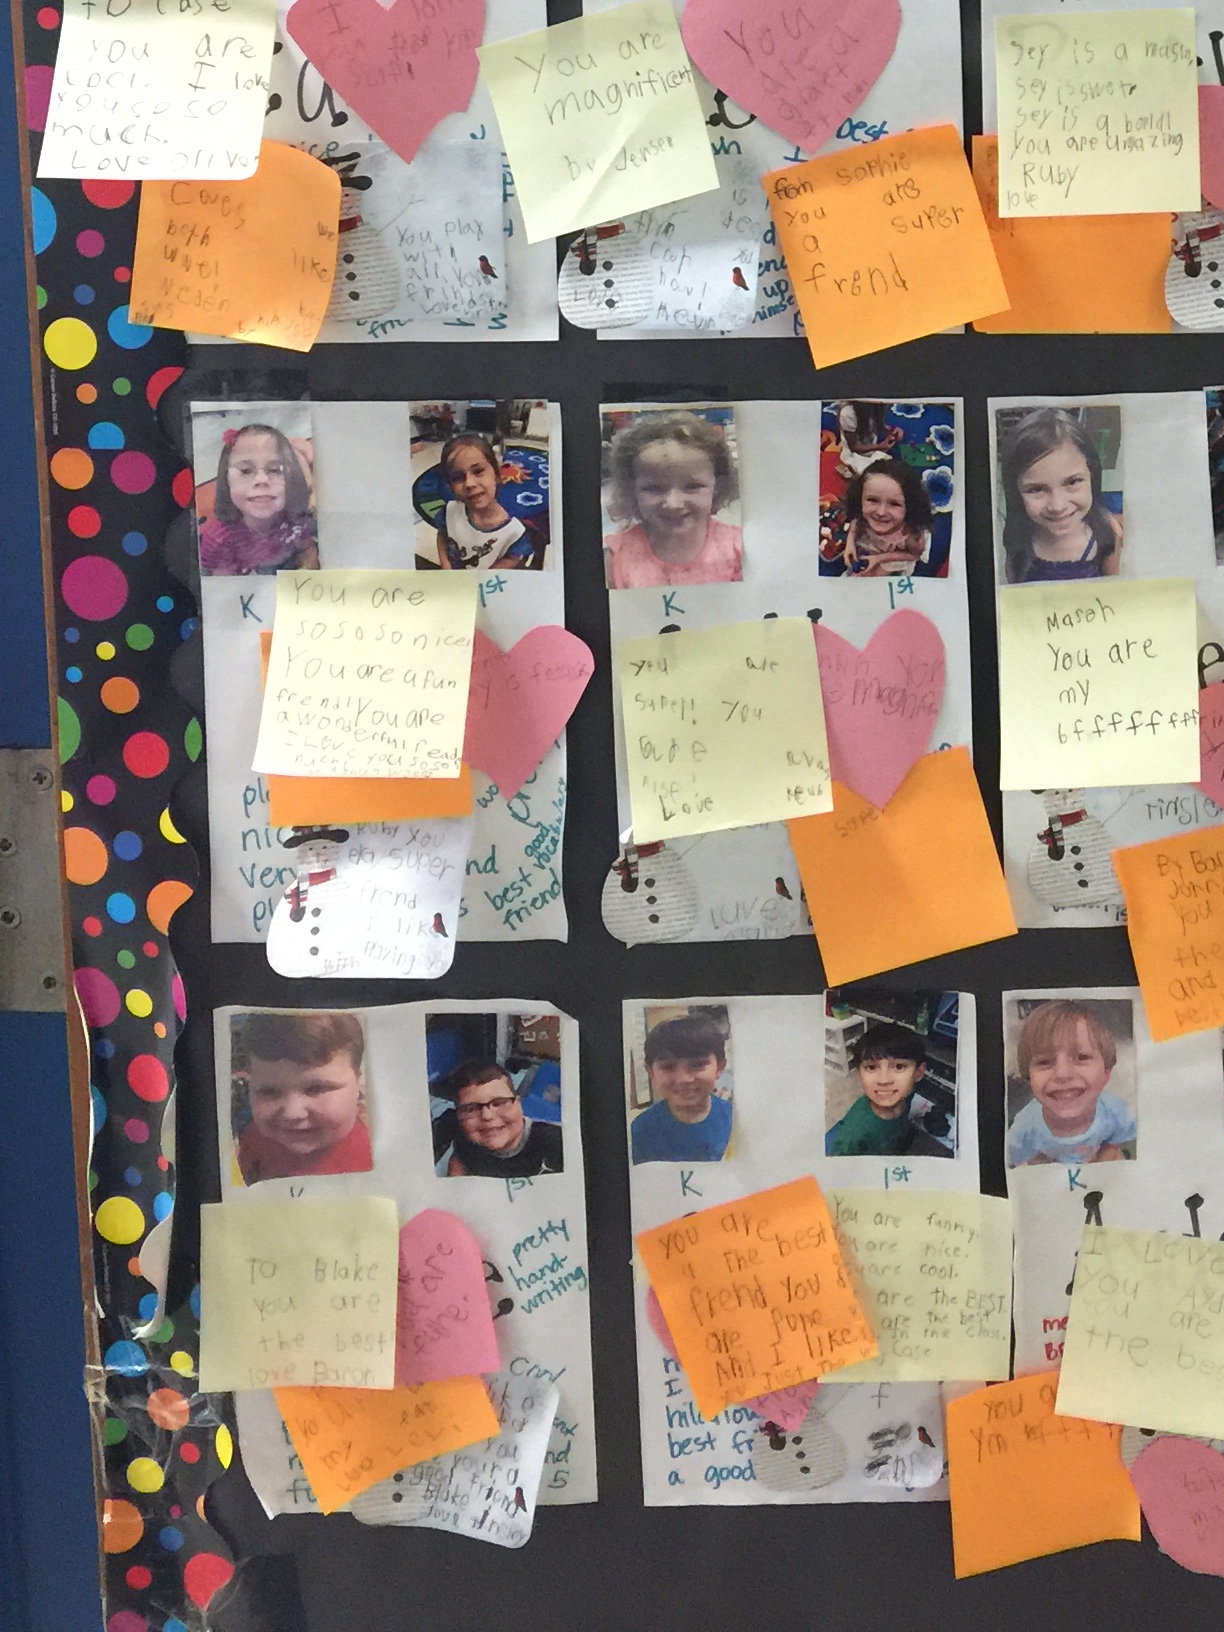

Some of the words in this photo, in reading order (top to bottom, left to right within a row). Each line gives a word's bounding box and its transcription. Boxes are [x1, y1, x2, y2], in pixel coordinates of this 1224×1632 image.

[240, 595, 262, 623] K
[663, 592, 685, 616] K
[681, 1170, 702, 1198] K
[1068, 1168, 1087, 1190] K
